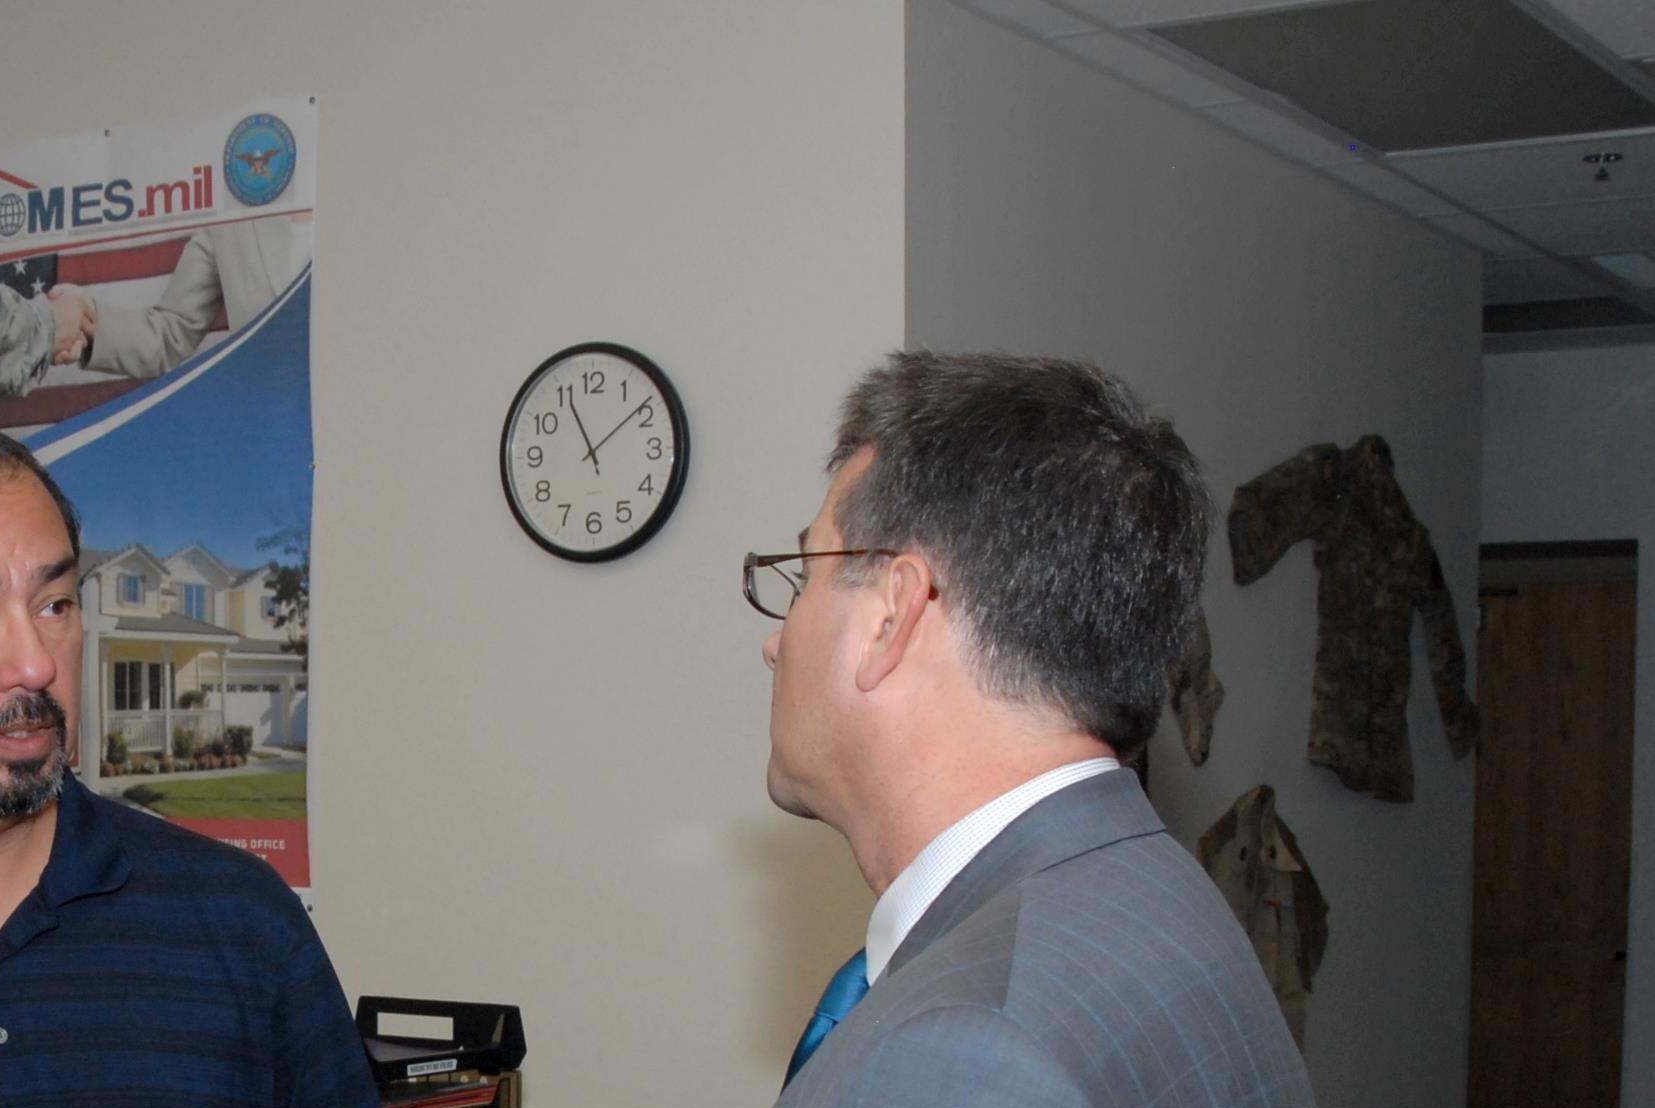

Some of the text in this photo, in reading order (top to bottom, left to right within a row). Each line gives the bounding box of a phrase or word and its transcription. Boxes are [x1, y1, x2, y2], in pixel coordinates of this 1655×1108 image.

[582, 371, 605, 394] 12
[557, 385, 573, 407] 11
[534, 412, 558, 435] 10
[638, 404, 654, 428] 2
[527, 446, 543, 468] 9
[646, 437, 662, 460] 3
[535, 480, 551, 502] 8
[637, 473, 654, 495] 4
[557, 504, 572, 526] 7
[616, 500, 632, 523] 5
[585, 512, 602, 534] 6
